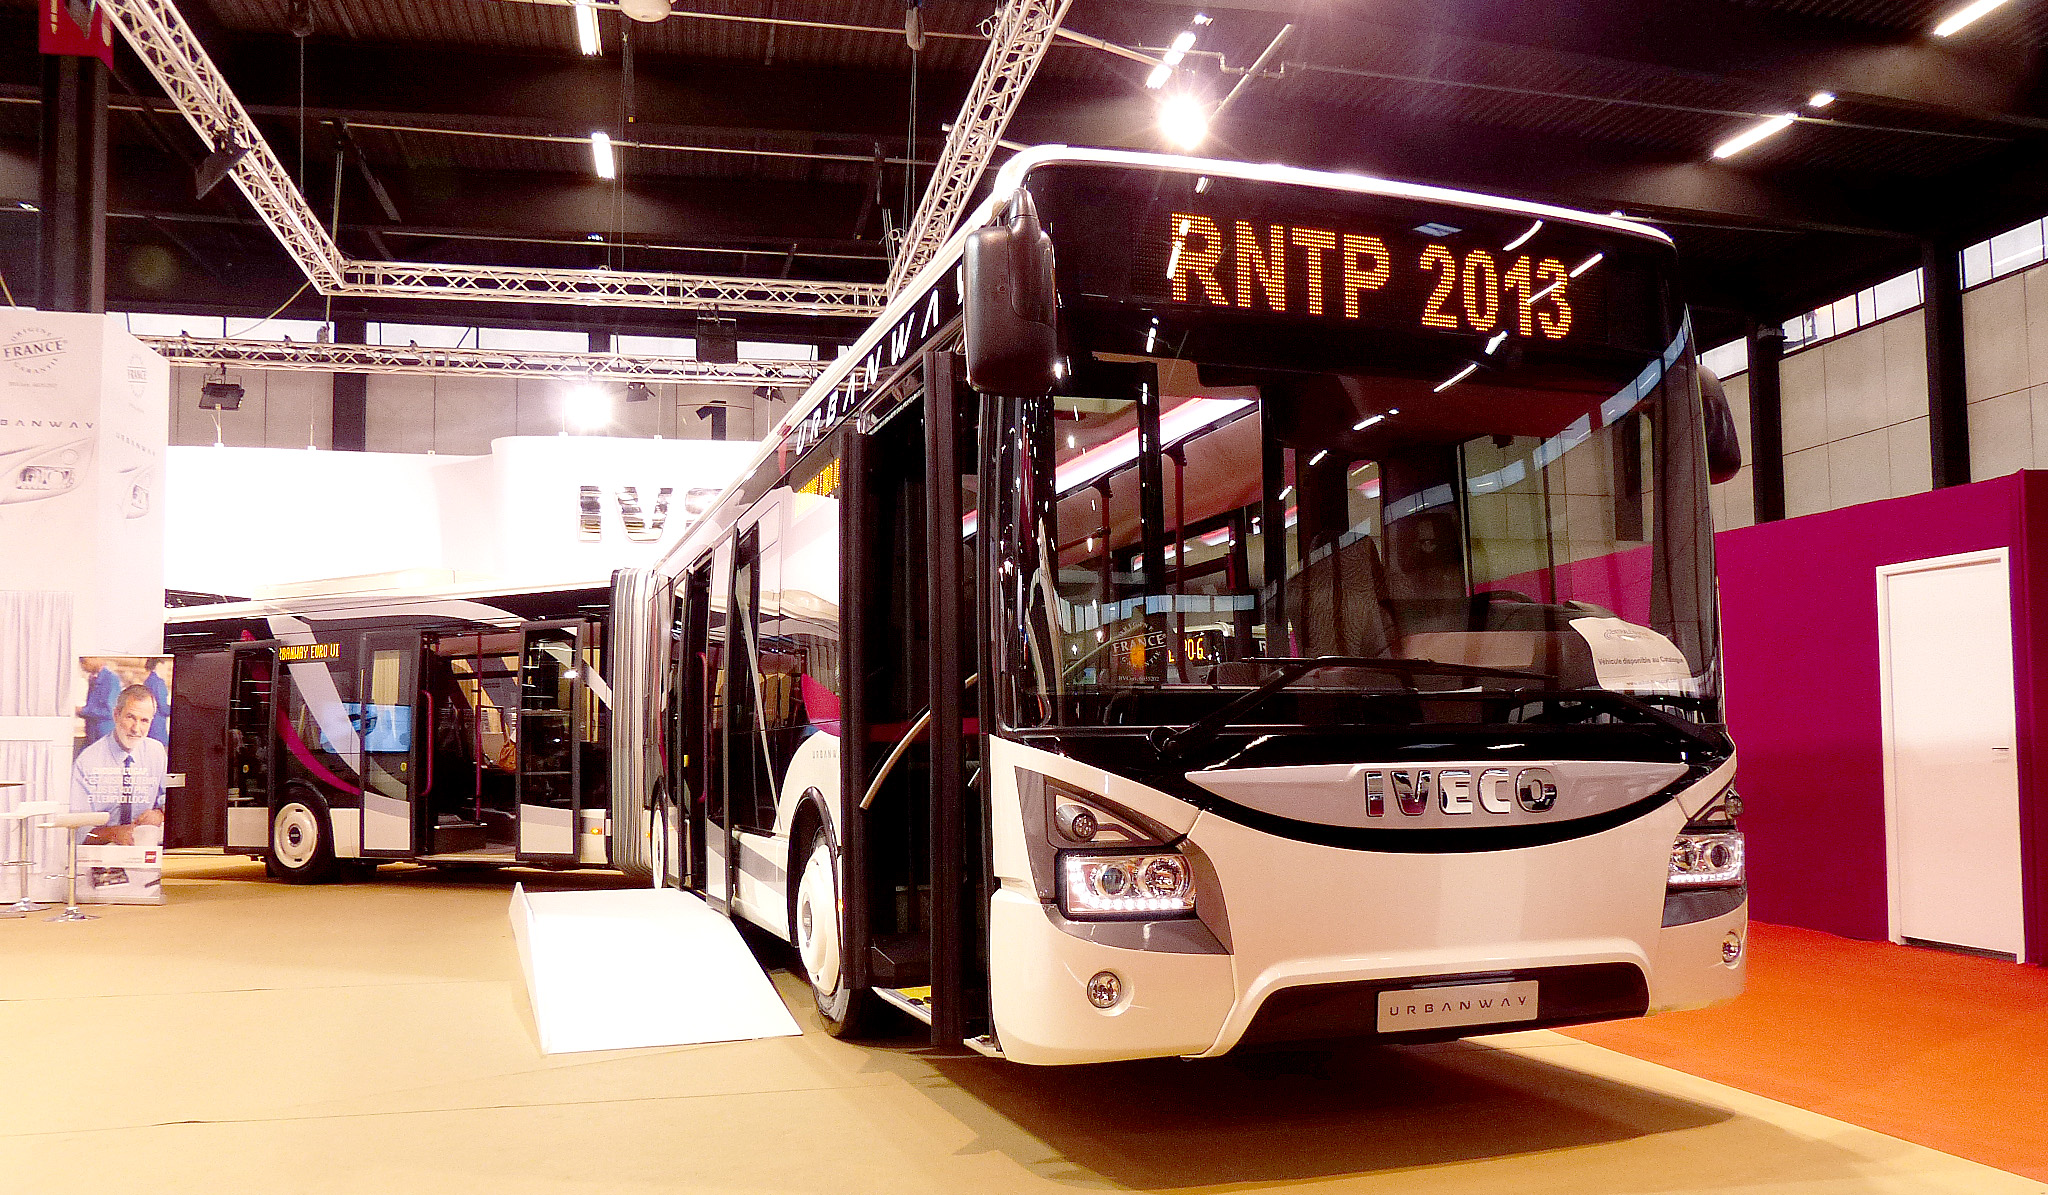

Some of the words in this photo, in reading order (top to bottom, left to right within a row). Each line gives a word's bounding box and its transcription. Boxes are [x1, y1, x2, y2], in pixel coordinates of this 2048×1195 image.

[1171, 212, 1390, 318] RNTP
[1419, 243, 1573, 339] 2013
[4, 340, 63, 358] FRANCE
[310, 644, 328, 659] EURO
[1112, 634, 1165, 654] FRANCE
[1623, 656, 1651, 666] disponible
[1365, 768, 1558, 817] IVECO
[1389, 995, 1527, 1017] URBANWAY
